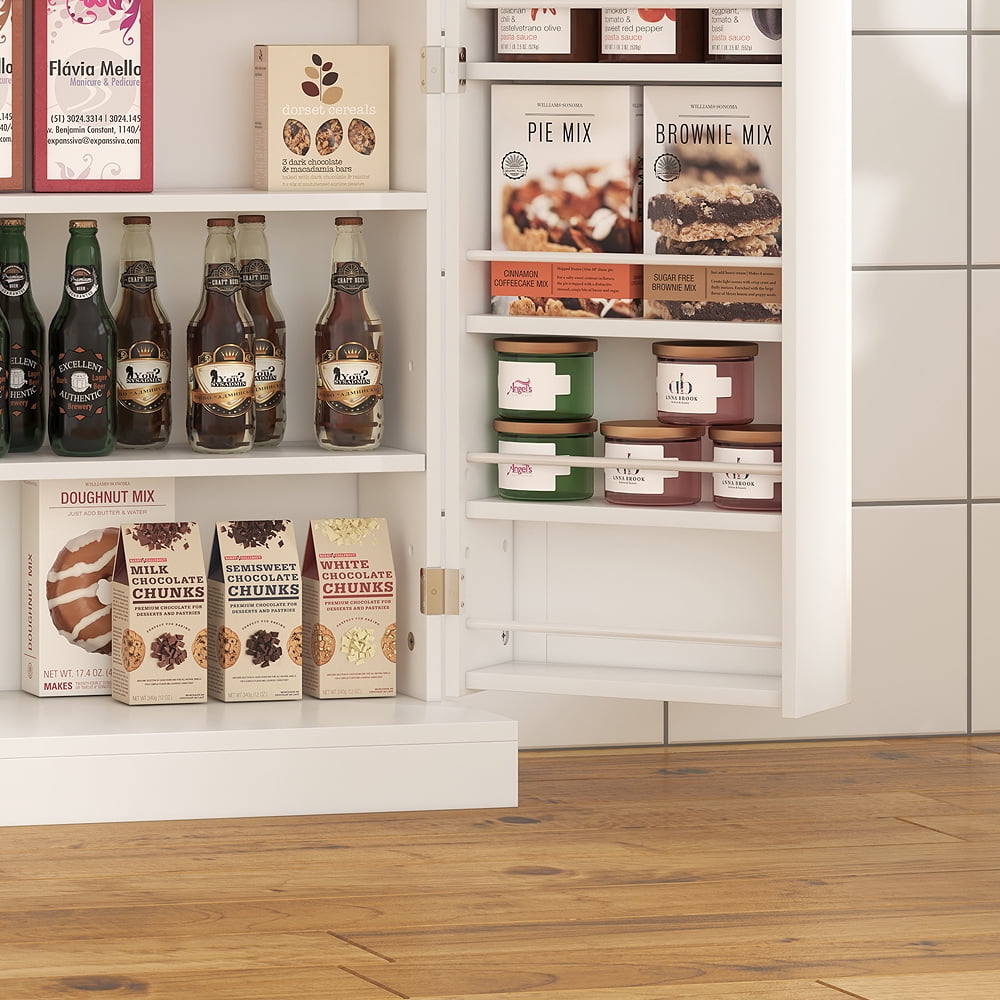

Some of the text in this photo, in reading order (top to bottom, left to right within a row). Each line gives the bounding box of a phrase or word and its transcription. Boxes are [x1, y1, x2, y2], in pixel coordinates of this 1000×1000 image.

[49, 60, 141, 76] Flávia Mello
[70, 77, 140, 86] Manicure Pedicure
[282, 104, 376, 115] dorset cereals
[51, 115, 64, 123] (51)
[56, 126, 116, 135] Benjamin Constant,
[528, 122, 592, 142] PIE MIX
[656, 124, 772, 145] BROWNIE MIX
[504, 270, 538, 278] CINNAMON
[654, 274, 694, 282] SUGAR FREE
[494, 279, 534, 287] COFFEECAKE
[652, 283, 682, 291] BROWNIE
[58, 360, 103, 373] EXCELLENT
[506, 378, 533, 396] Angel's
[59, 390, 102, 402] AUTHENTIC
[68, 403, 92, 411] Brewery
[61, 490, 155, 504] DOUGHNUT MIX
[226, 564, 296, 572] SEMISWEET
[320, 560, 369, 569] WHITE
[130, 566, 168, 574] MILK
[228, 574, 298, 582] CHOCOLATE
[322, 571, 392, 580] CHOCOLATE
[132, 576, 204, 585] CHOCOLATE
[228, 584, 299, 596] CHUNKS
[323, 582, 393, 594] CHUNKS
[133, 587, 204, 599] CHUNKS
[44, 669, 104, 678] NET WT. 17.4 OZ.
[44, 682, 72, 690] MAKES
